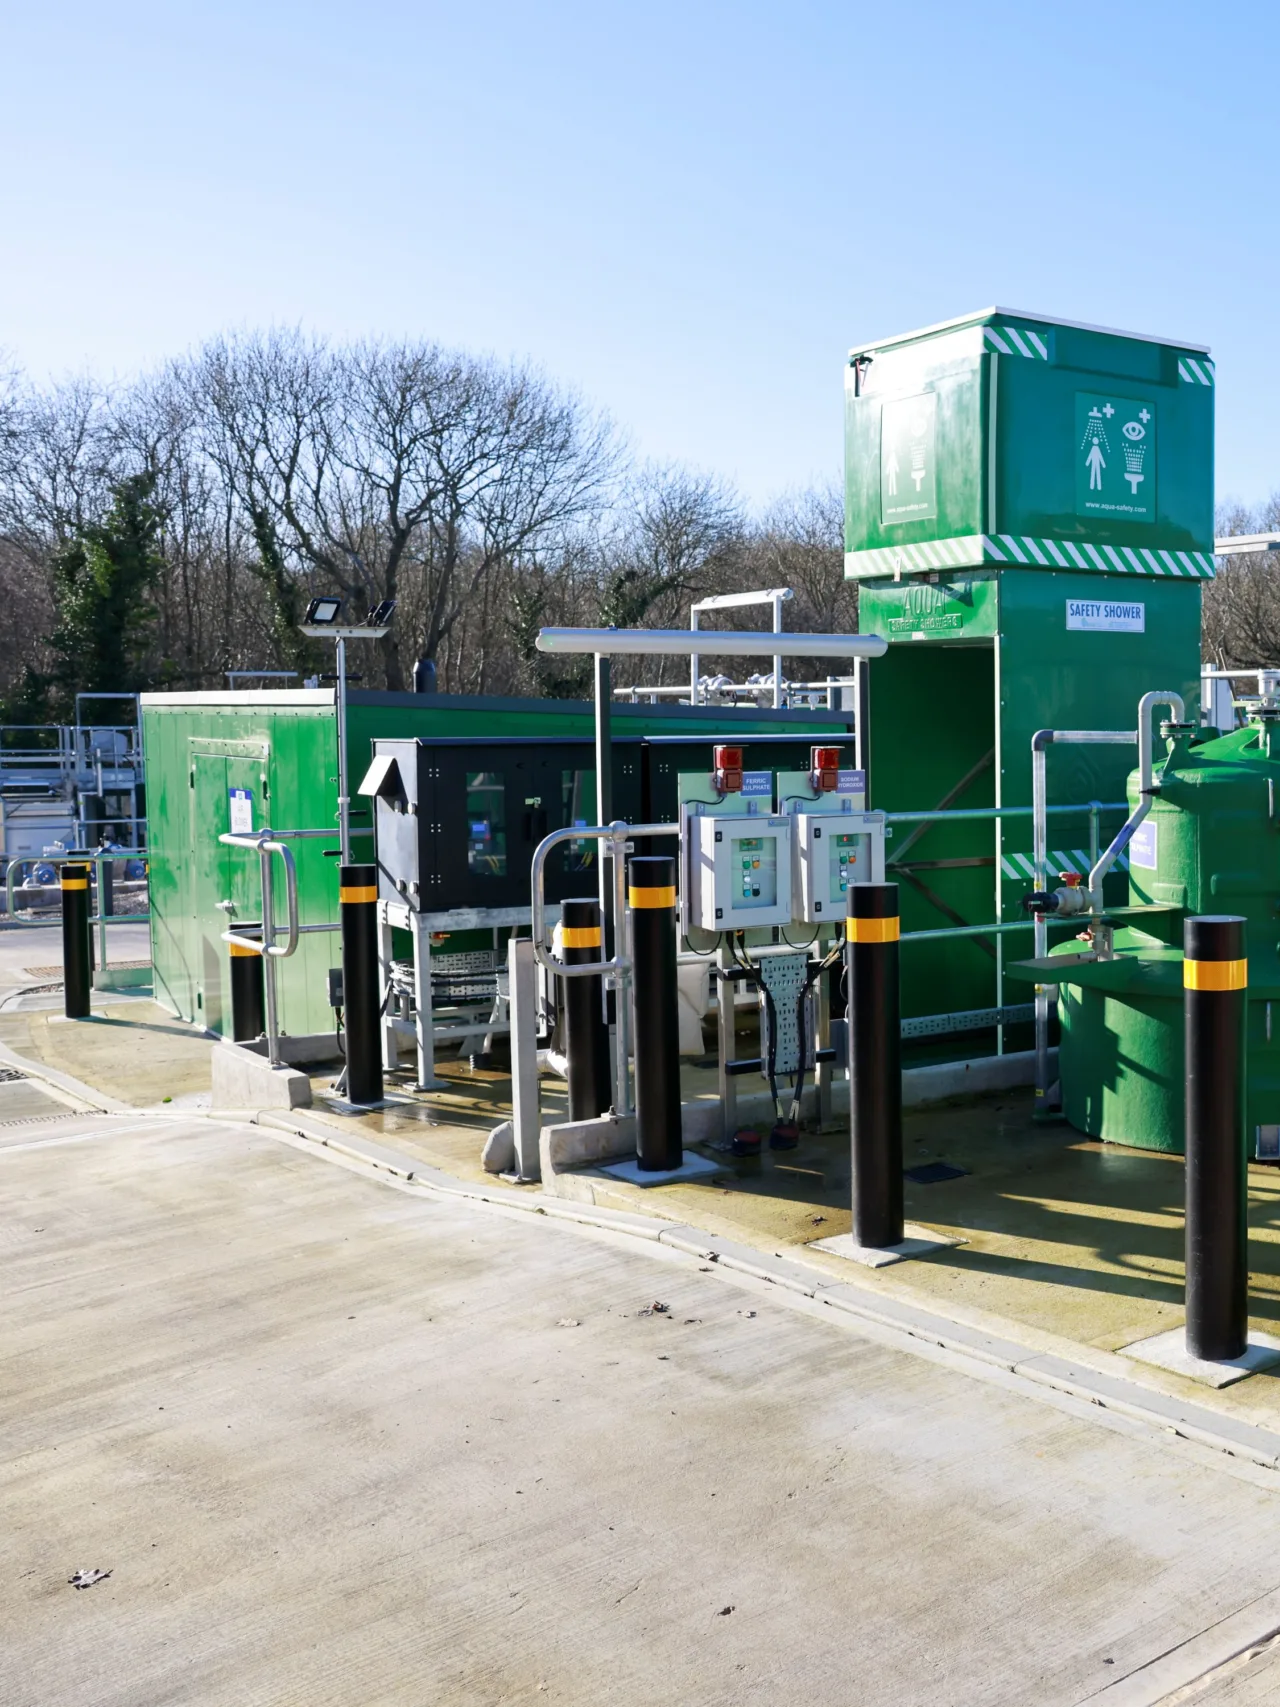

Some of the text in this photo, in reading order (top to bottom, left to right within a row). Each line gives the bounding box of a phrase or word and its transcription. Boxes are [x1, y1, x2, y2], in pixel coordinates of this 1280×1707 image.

[1085, 502, 1147, 513] www.aqua-safety.com
[903, 585, 946, 617] AQUA
[1069, 603, 1142, 619] SAFETY SHOWER
